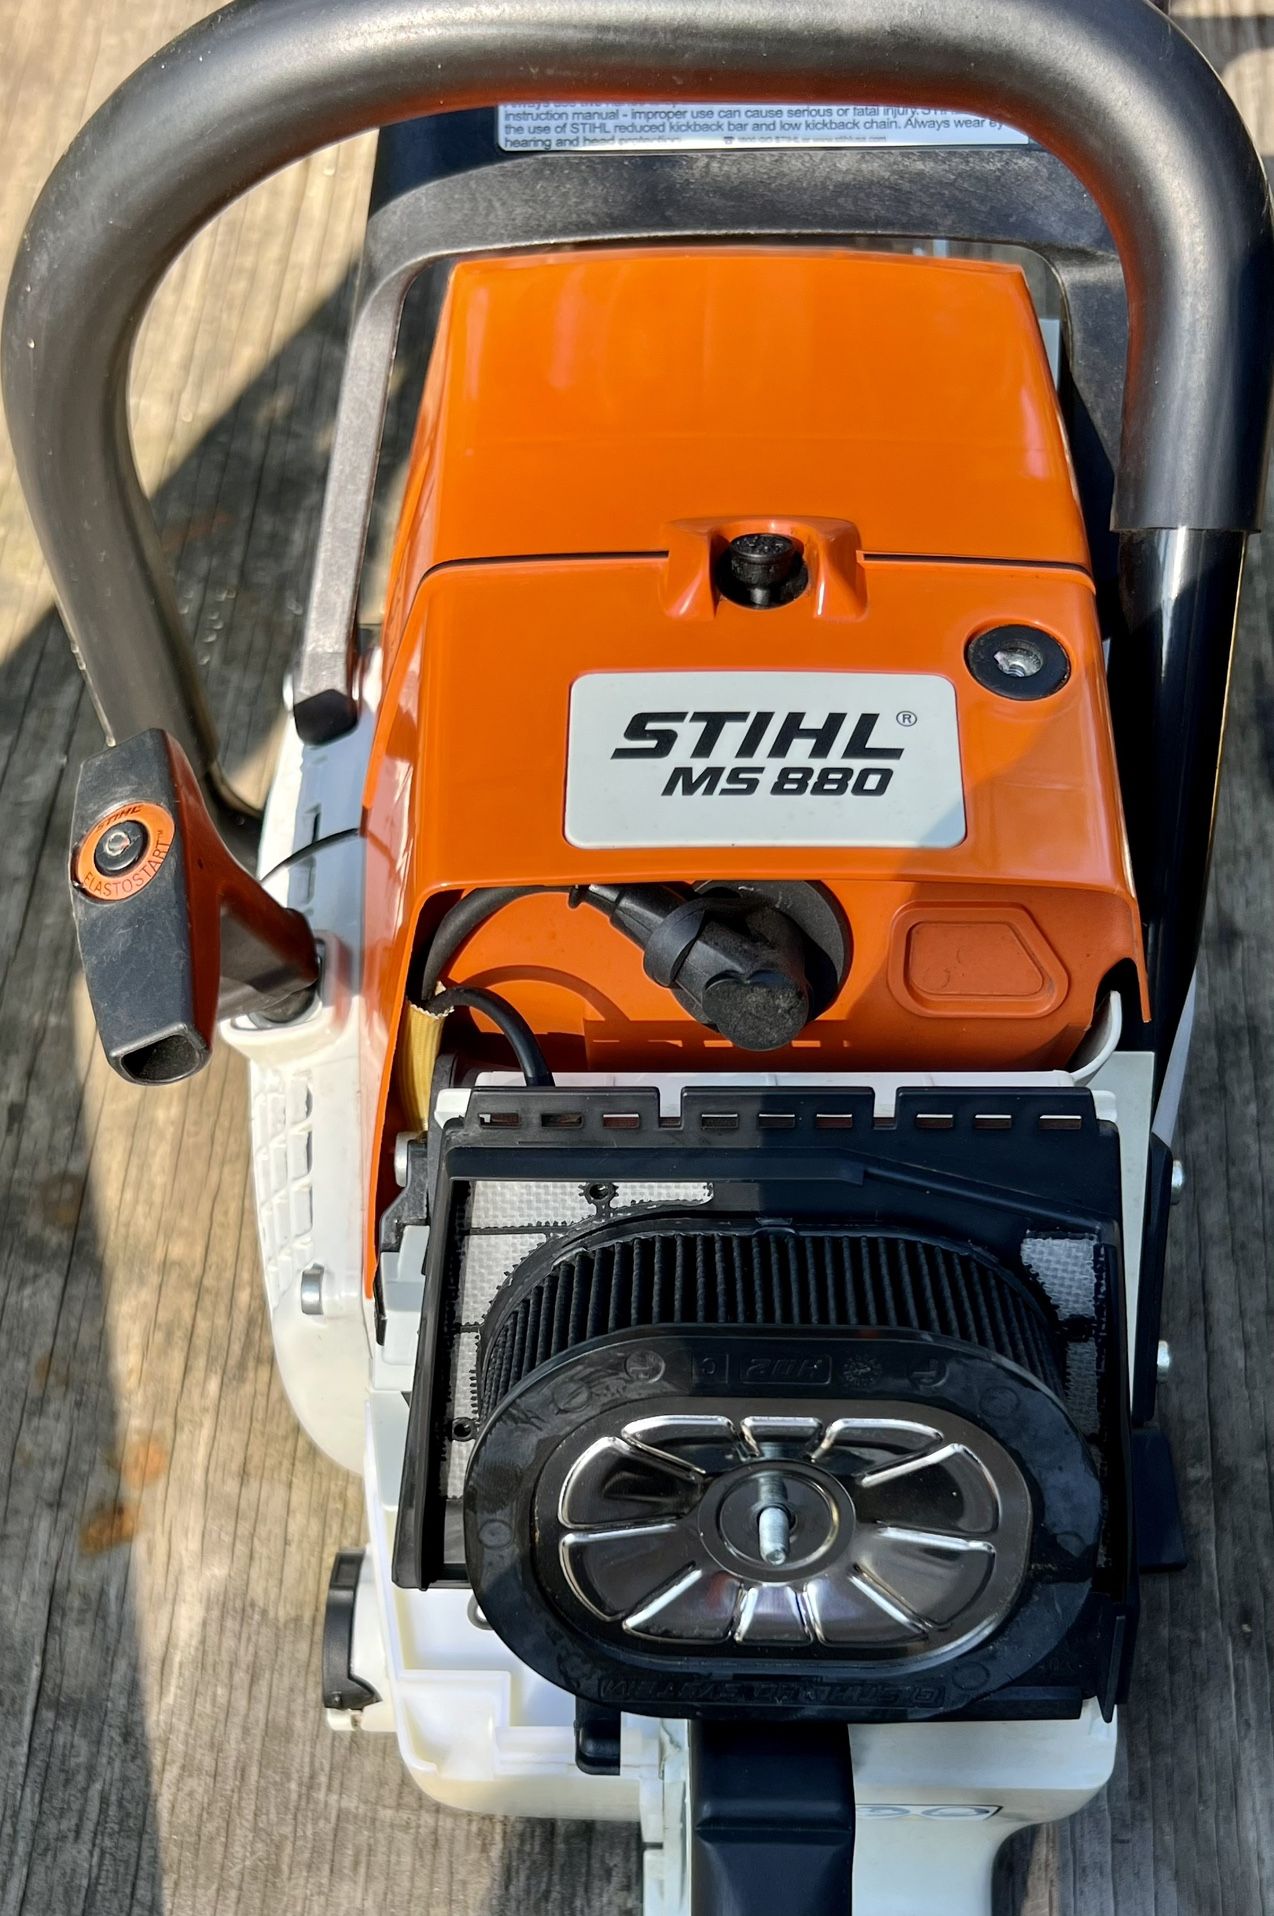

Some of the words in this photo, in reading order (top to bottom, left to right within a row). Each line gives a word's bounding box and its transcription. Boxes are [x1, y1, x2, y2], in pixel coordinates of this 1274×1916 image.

[504, 110, 569, 121] instruction
[572, 109, 620, 121] manual
[631, 109, 688, 124] improper
[691, 110, 714, 119] use
[718, 109, 741, 119] can
[745, 108, 783, 118] cause
[787, 106, 833, 118] serious
[837, 107, 850, 116] or
[853, 106, 880, 116] fatal
[504, 125, 525, 135] the
[528, 126, 551, 135] use
[554, 123, 568, 134] of
[570, 123, 611, 133] STIHL
[613, 122, 665, 133] reduced
[669, 121, 724, 133] kickback
[727, 121, 749, 132] bar
[752, 120, 776, 131] and
[779, 120, 802, 131] low
[805, 119, 860, 130] kickback
[863, 118, 901, 130] chain.
[904, 118, 950, 131] Always
[953, 119, 986, 128] wear
[989, 119, 1004, 130] ey
[504, 137, 551, 150] hearing
[555, 136, 580, 147] and
[610, 711, 905, 760] STIHL
[661, 766, 765, 797] MS
[770, 767, 894, 797] 880
